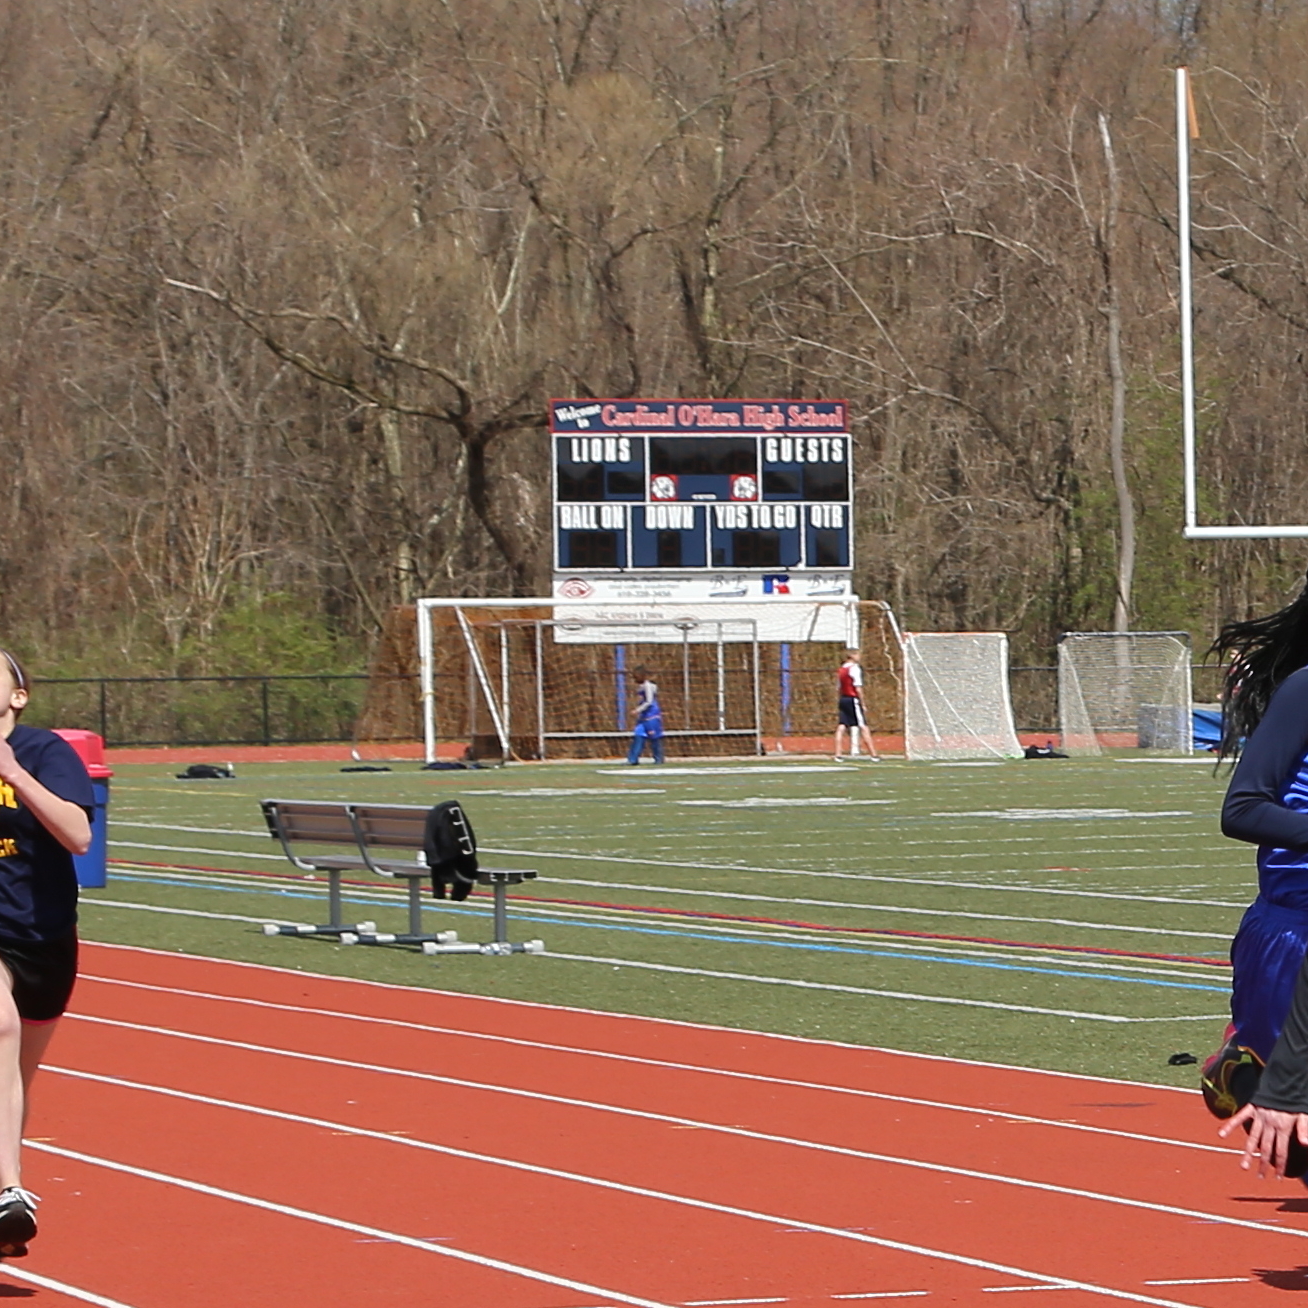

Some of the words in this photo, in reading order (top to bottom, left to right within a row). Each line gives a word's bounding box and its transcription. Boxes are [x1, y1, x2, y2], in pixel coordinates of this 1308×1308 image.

[601, 404, 675, 427] Cardinal
[677, 404, 741, 427] O'Hara
[742, 405, 785, 430] High
[787, 405, 843, 427] School
[571, 438, 630, 462] LIONS
[765, 438, 843, 462] GUESTS
[560, 505, 598, 529] BALL
[600, 505, 624, 529] ON
[645, 505, 694, 529] DOWN
[715, 505, 748, 529] YDS
[750, 505, 771, 529] TO
[773, 505, 796, 529] GO
[811, 505, 843, 529] QTR
